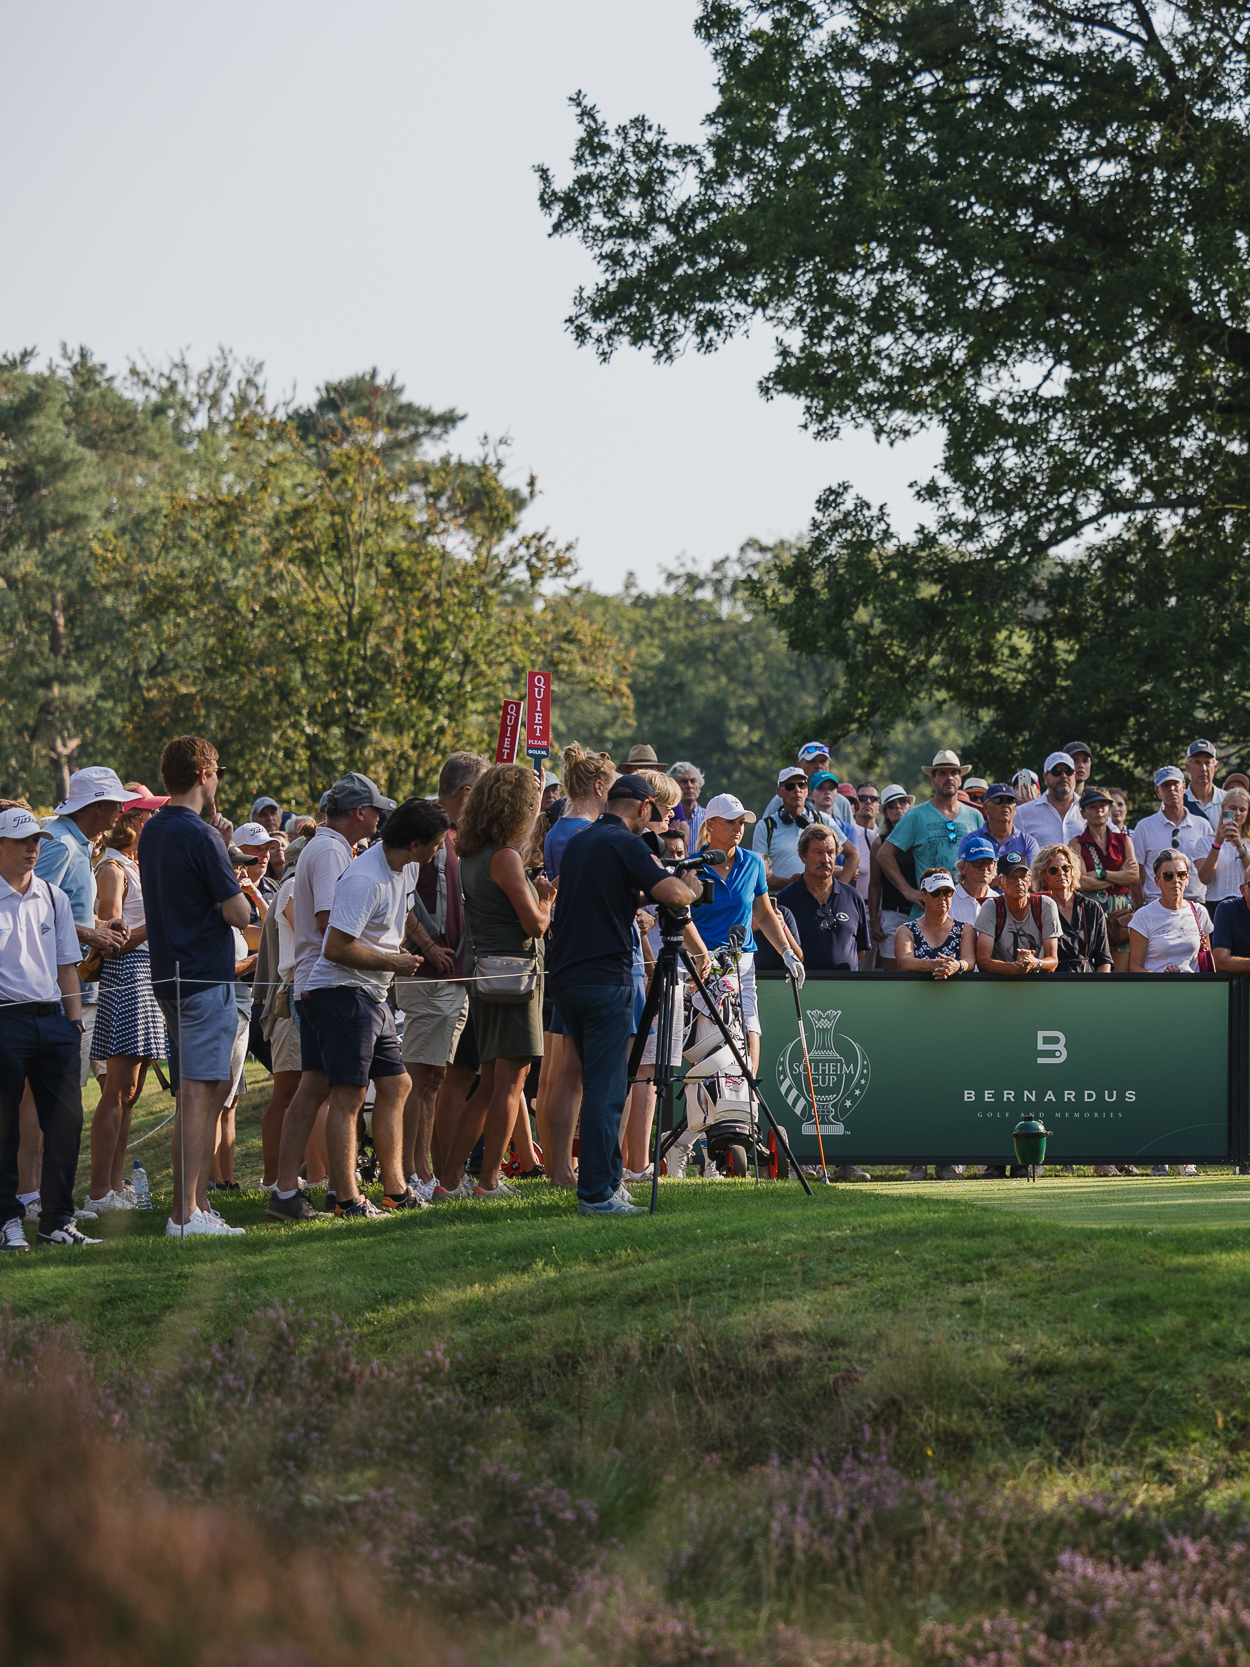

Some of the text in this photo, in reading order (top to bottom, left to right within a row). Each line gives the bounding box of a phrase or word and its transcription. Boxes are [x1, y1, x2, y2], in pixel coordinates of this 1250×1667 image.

[534, 675, 545, 736] QUIET
[503, 704, 516, 759] QUIET
[809, 1075, 837, 1088] CUP
[963, 1090, 1137, 1102] BERNARDUS
